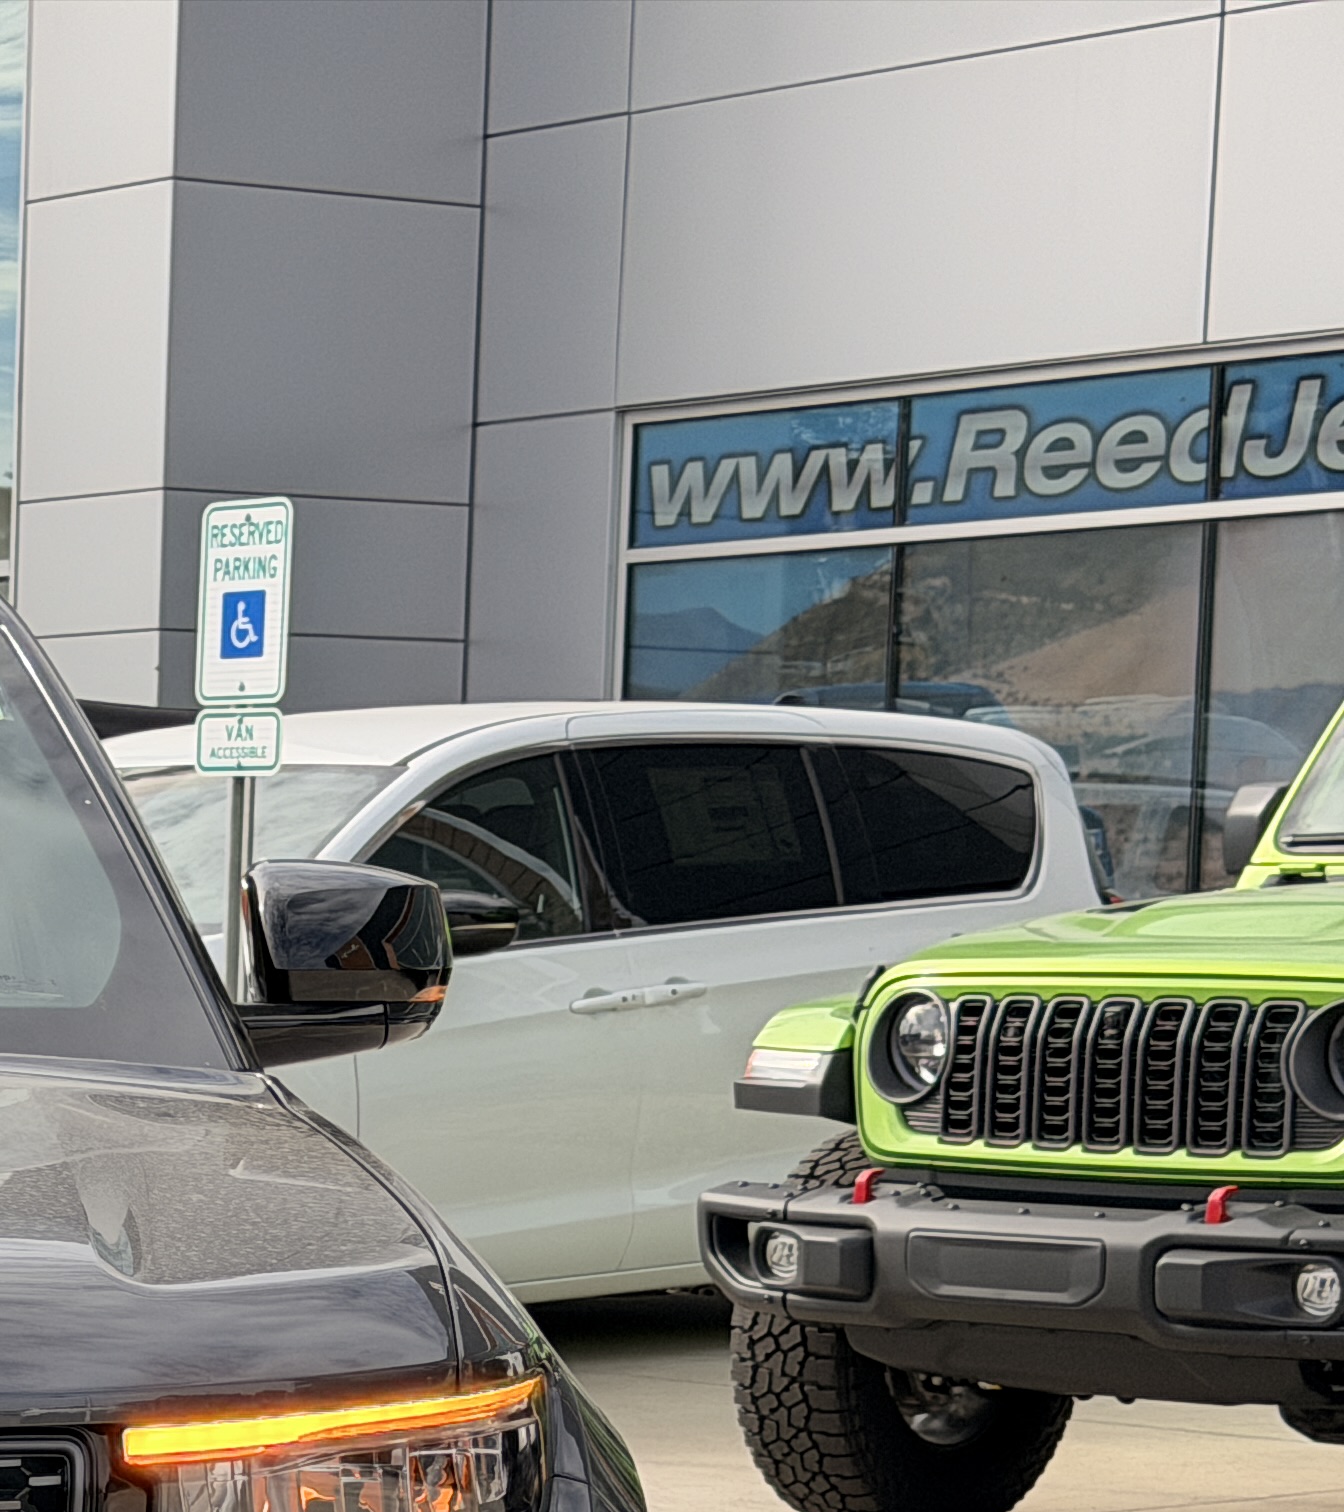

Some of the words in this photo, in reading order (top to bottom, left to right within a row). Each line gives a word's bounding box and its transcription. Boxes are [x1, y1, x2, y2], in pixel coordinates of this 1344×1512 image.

[210, 520, 283, 548] RESERVED
[213, 554, 278, 582] PARKING
[225, 724, 254, 741] VAN
[209, 746, 267, 759] ACCESSIBLE
